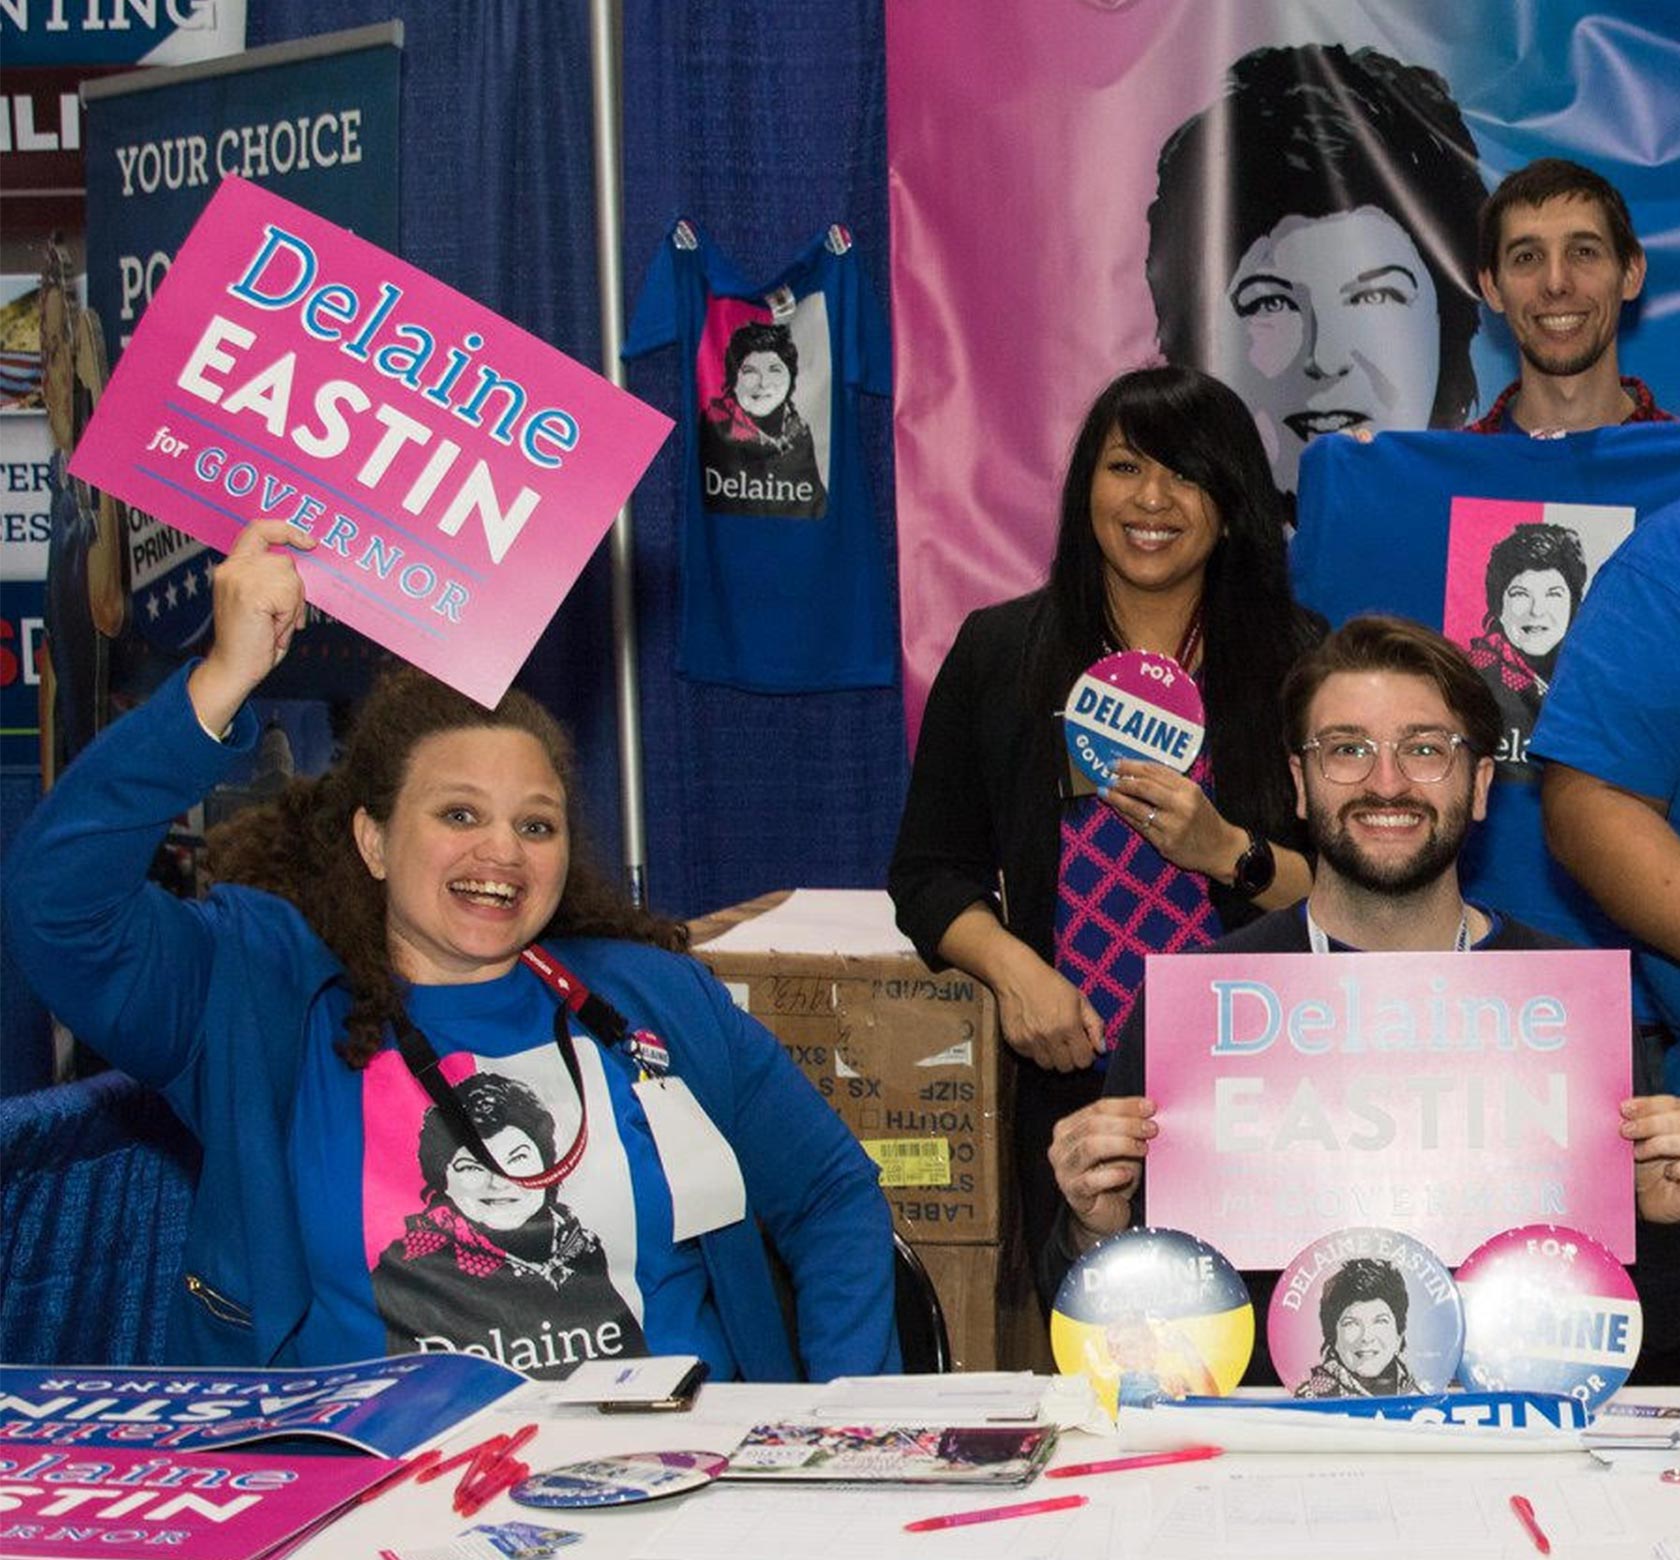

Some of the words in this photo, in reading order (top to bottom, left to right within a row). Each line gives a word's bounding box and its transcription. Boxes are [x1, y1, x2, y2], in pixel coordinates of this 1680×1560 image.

[116, 135, 208, 197] YOUR
[215, 109, 363, 181] CHOICE
[226, 223, 582, 469] Delaine
[176, 314, 542, 565] EASTIN
[705, 466, 814, 502] Delaine
[147, 426, 190, 459] for
[194, 446, 471, 623] GOVERNOR
[1073, 685, 1194, 760] DELAINE
[1209, 976, 1567, 1057] Delaine
[848, 1078, 881, 1099] XS
[886, 1110, 974, 1132] YOUTH
[1213, 1072, 1569, 1153] EASTIN
[1282, 1234, 1370, 1311] DELAINE
[1378, 1237, 1451, 1306] EASTIN
[1526, 1238, 1579, 1263] FOR
[0, 1378, 399, 1422] EASTIN
[0, 1401, 361, 1446] Delain
[0, 1452, 299, 1491] laine
[0, 1485, 264, 1523] STIN
[0, 1524, 191, 1545] RNOR
